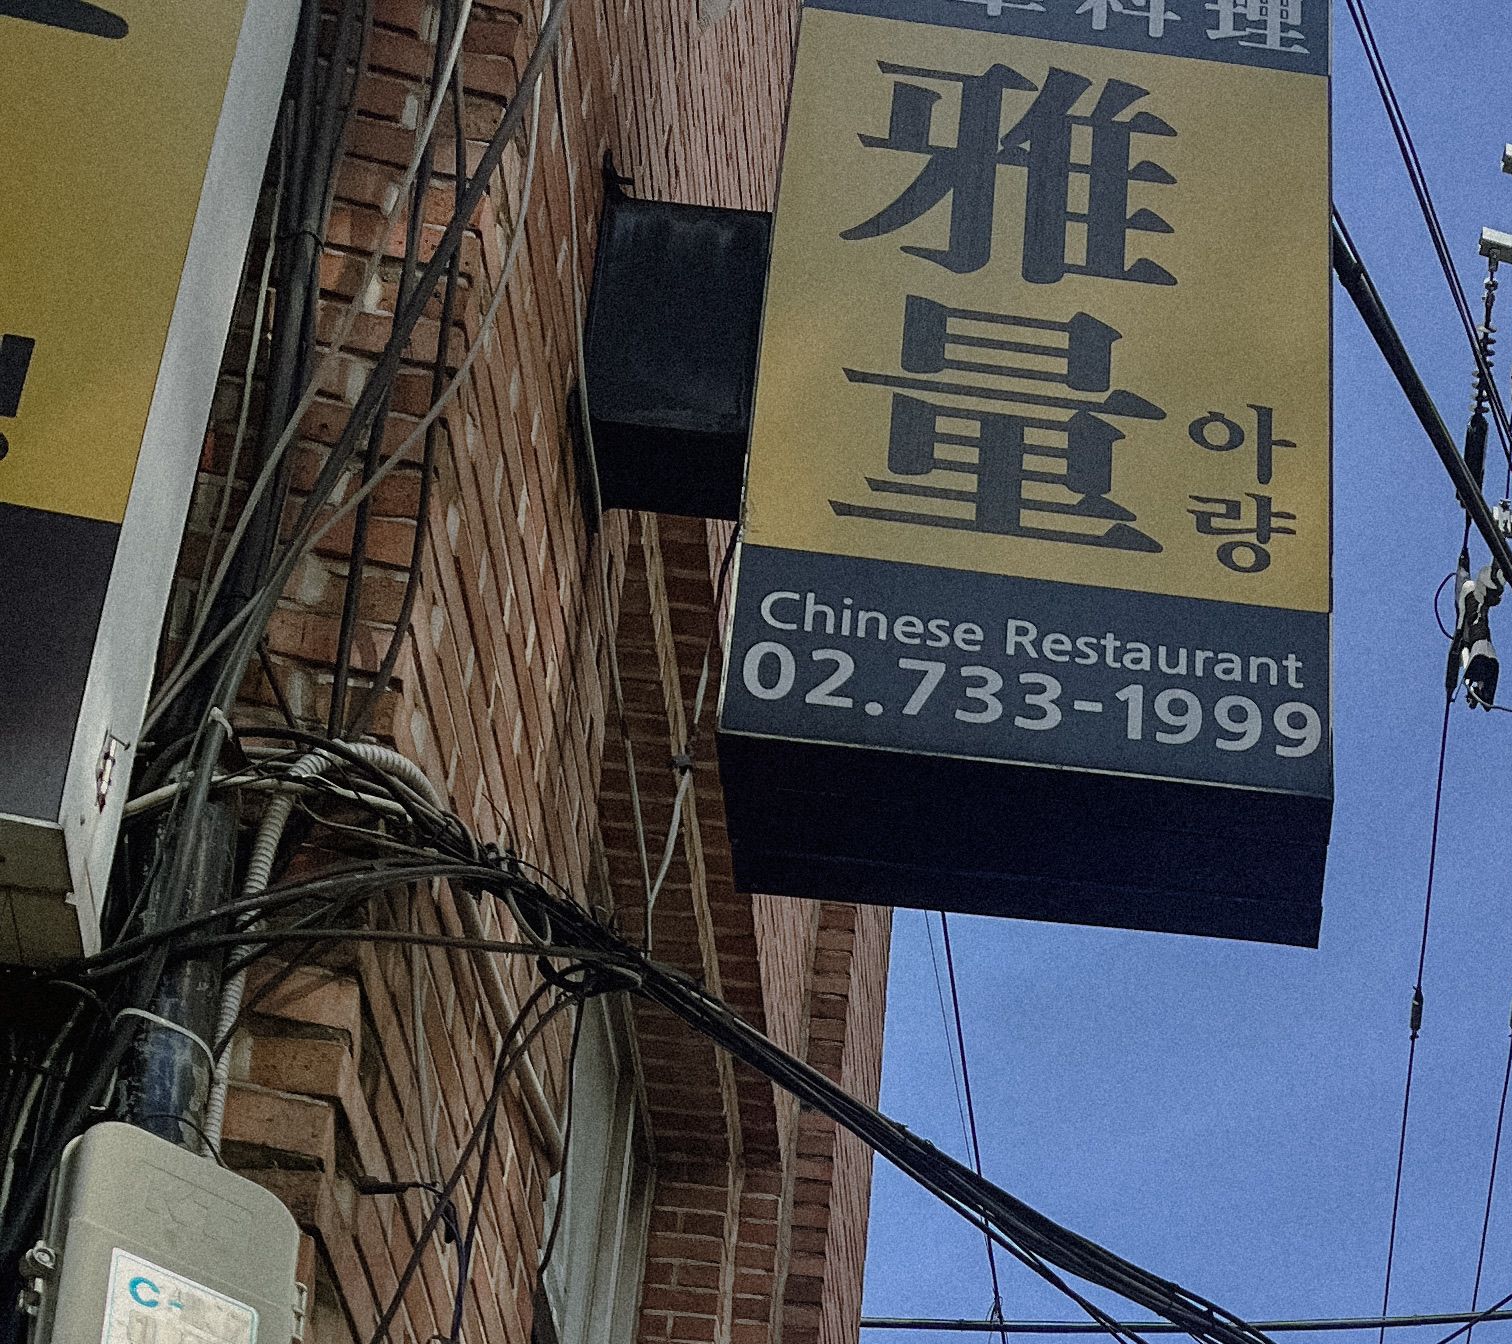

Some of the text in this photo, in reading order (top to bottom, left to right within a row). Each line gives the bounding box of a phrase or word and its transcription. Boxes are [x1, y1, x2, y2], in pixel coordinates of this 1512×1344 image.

[1186, 402, 1298, 575] 아량
[740, 638, 1323, 762] 02.733-1999
[757, 588, 1306, 692] Chinese Restaurant
